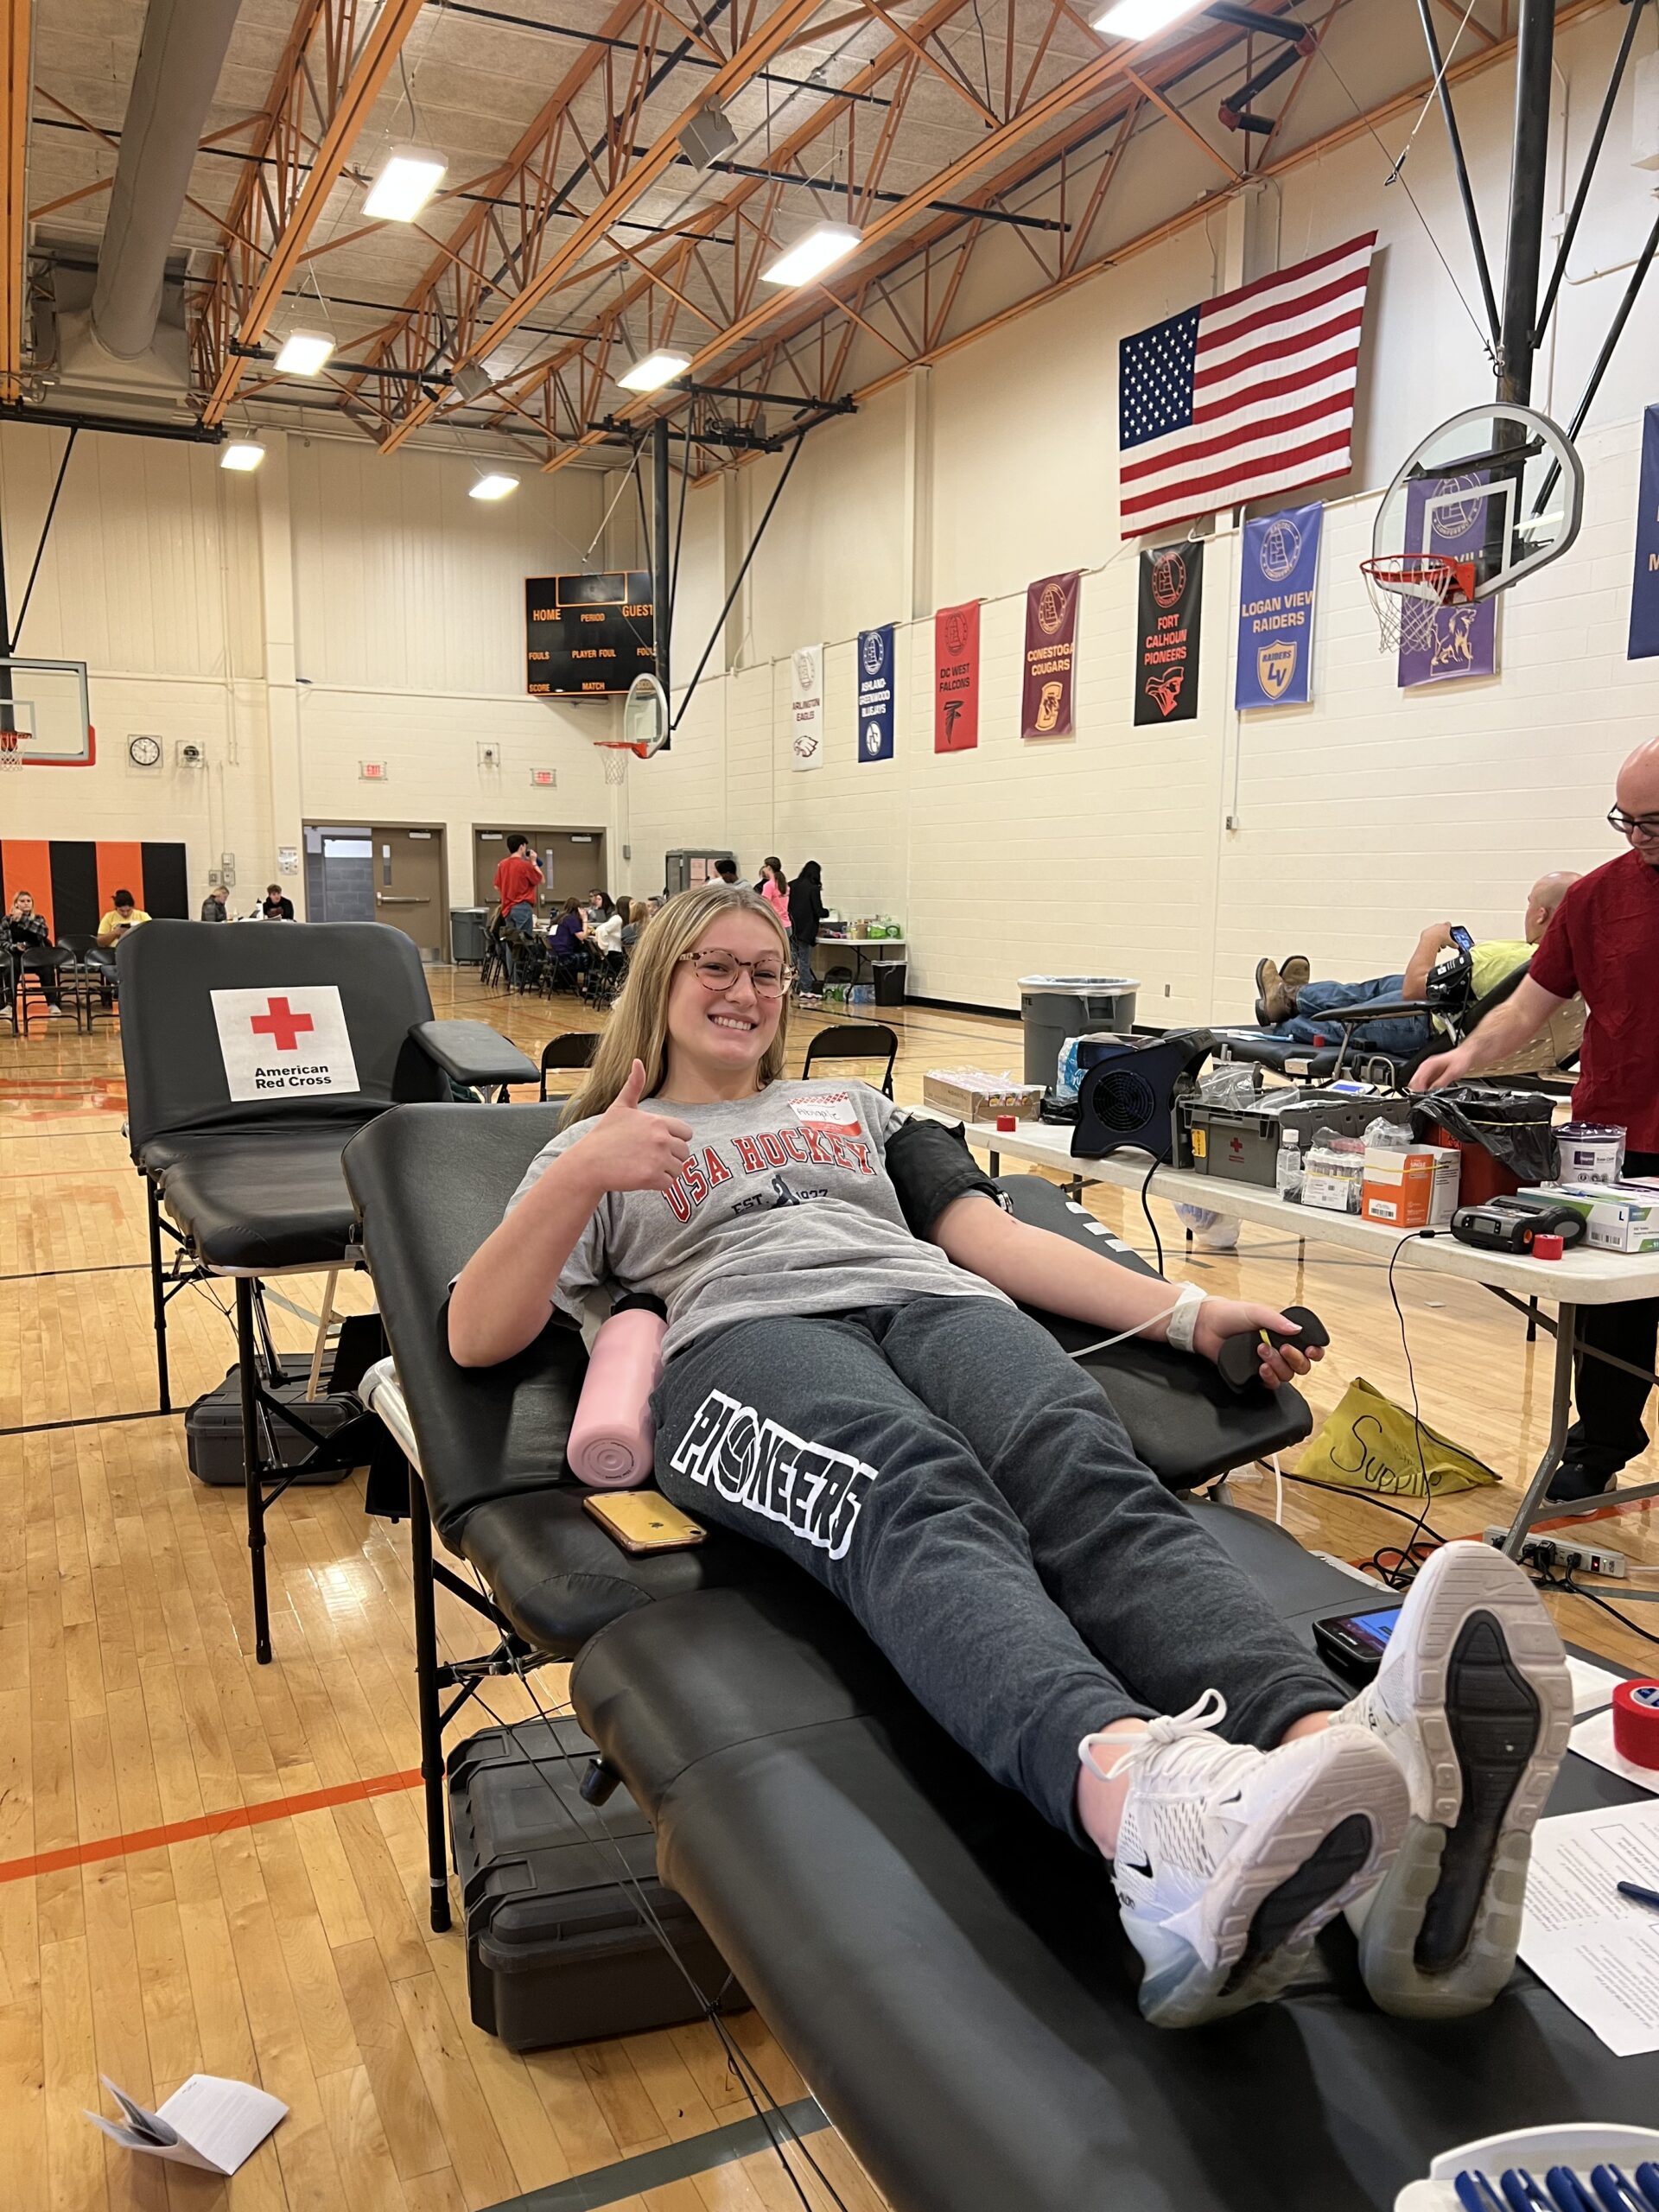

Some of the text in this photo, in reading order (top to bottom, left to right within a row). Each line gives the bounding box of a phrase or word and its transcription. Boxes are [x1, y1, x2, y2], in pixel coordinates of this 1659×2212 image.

[622, 605, 653, 617] GUEST
[1242, 596, 1281, 618] LOGAN
[533, 609, 561, 621] HOME
[581, 613, 605, 622] PERIOD
[1158, 613, 1179, 630] FORT
[1253, 611, 1305, 633] RAIDERS
[1146, 629, 1187, 649] CALHOUN
[529, 651, 550, 660] FOULS
[572, 649, 616, 658] PLAYER FOUL
[1027, 642, 1074, 662] CONESTOGA
[1144, 645, 1186, 665] PIONEERS
[1262, 651, 1292, 663] RAIDERS
[940, 663, 969, 678] DC WEST
[1031, 658, 1071, 676] COUGARS
[529, 683, 550, 692] SCORE
[582, 682, 605, 690] MATCH
[939, 677, 969, 692] FALCONS
[255, 1065, 329, 1077] American
[255, 1076, 332, 1090] Red Cross
[661, 1126, 878, 1224] USA HOCKEY
[731, 1193, 770, 1215] EST.
[1618, 1210, 1624, 1222] L
